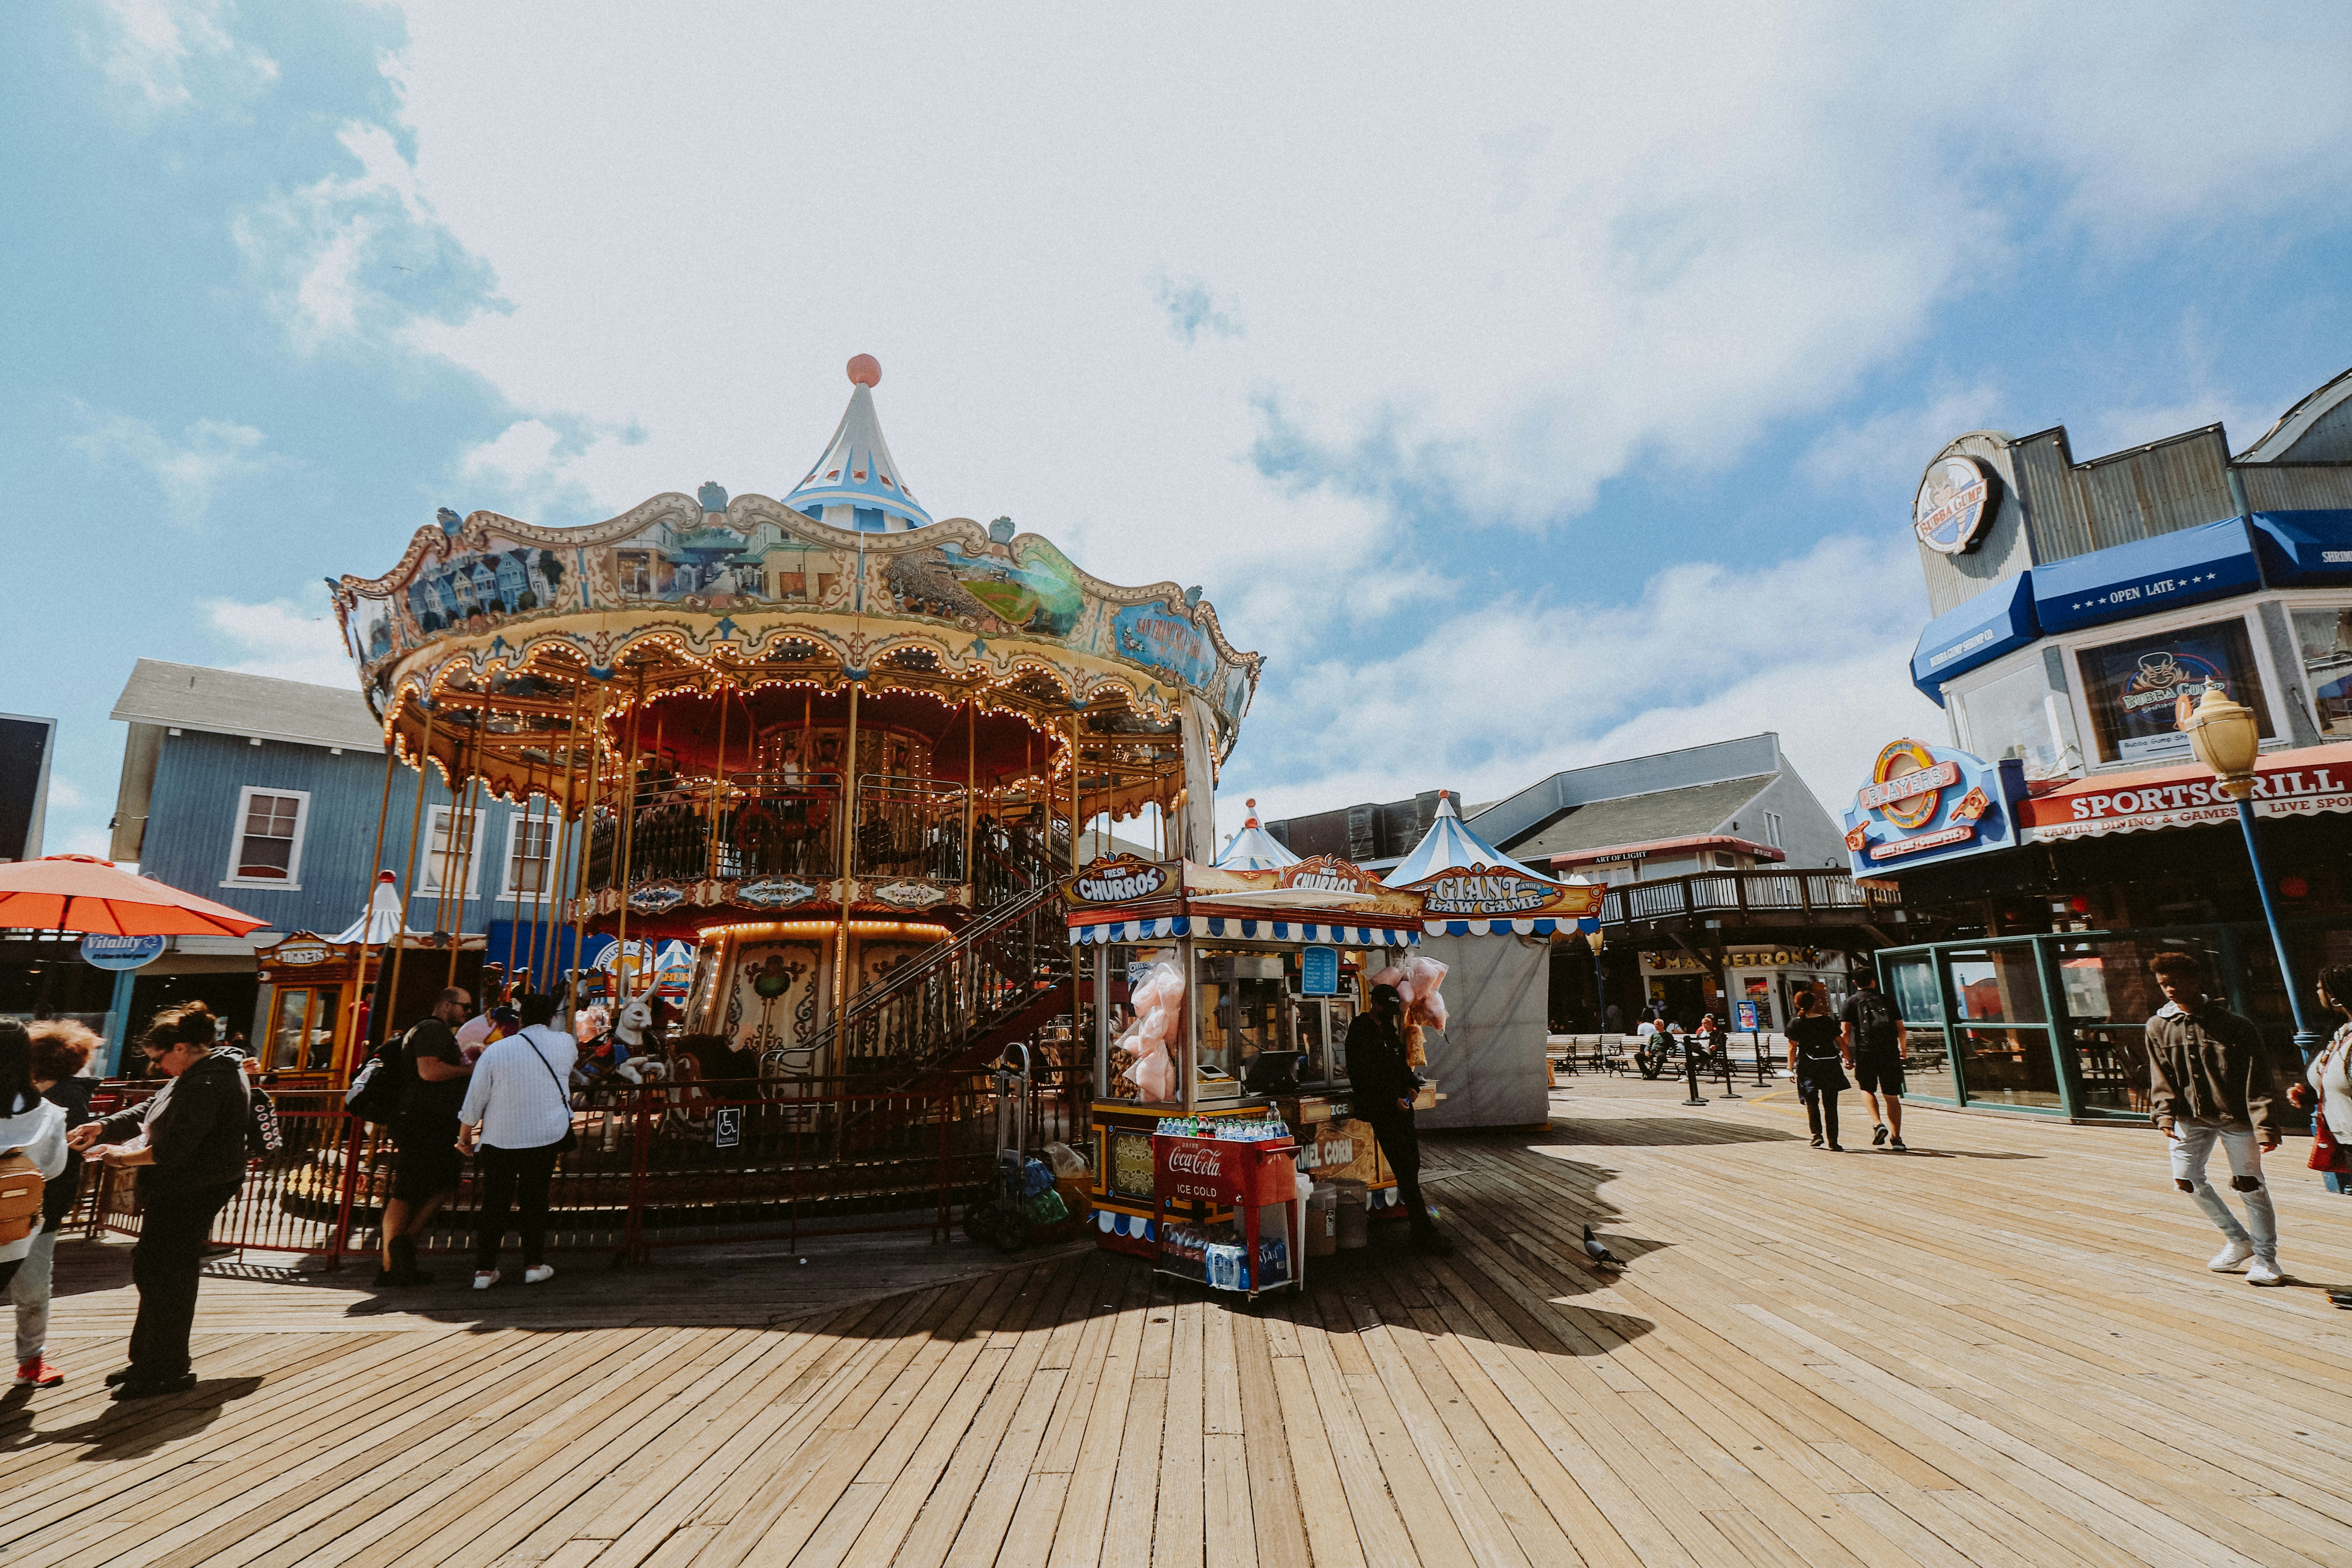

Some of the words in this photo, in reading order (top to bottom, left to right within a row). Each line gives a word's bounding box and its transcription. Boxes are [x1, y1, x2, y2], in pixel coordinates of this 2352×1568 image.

[1920, 505, 1952, 535] BUBBA
[1954, 486, 1982, 510] GUMP
[1932, 517, 1956, 538] SHRIMP
[2110, 587, 2141, 603] OPEN
[2145, 579, 2175, 596] LATE
[1136, 619, 1152, 636] SAN
[1929, 651, 1948, 668] BUBBA
[2122, 687, 2177, 709] BUBBA
[1868, 767, 1943, 806] PLAYERS
[2044, 824, 2093, 837] FAMILY
[2101, 816, 2155, 830] DINING
[2162, 815, 2173, 823] &
[2180, 808, 2239, 821] GAMES
[2269, 800, 2310, 812] LIVE
[2317, 797, 2352, 808] SPO
[1623, 851, 1647, 860] LIGHT
[1103, 867, 1126, 879] FRESH
[1320, 867, 1337, 876] FRESH
[1079, 867, 1158, 900] CHURROS
[1292, 873, 1358, 893] CHURROS
[1436, 876, 1522, 901] GIANT
[1517, 882, 1542, 891] FAMOUS
[1426, 898, 1477, 914] LAW
[1480, 894, 1543, 914] GAME
[88, 935, 144, 952] Vitality
[1129, 963, 1148, 973] OREO
[1330, 1104, 1348, 1115] ICE
[1169, 1146, 1222, 1176] Coca-Cola
[1324, 1139, 1353, 1165] CORN
[1177, 1184, 1191, 1194] ICE
[1194, 1186, 1216, 1197] COLD
